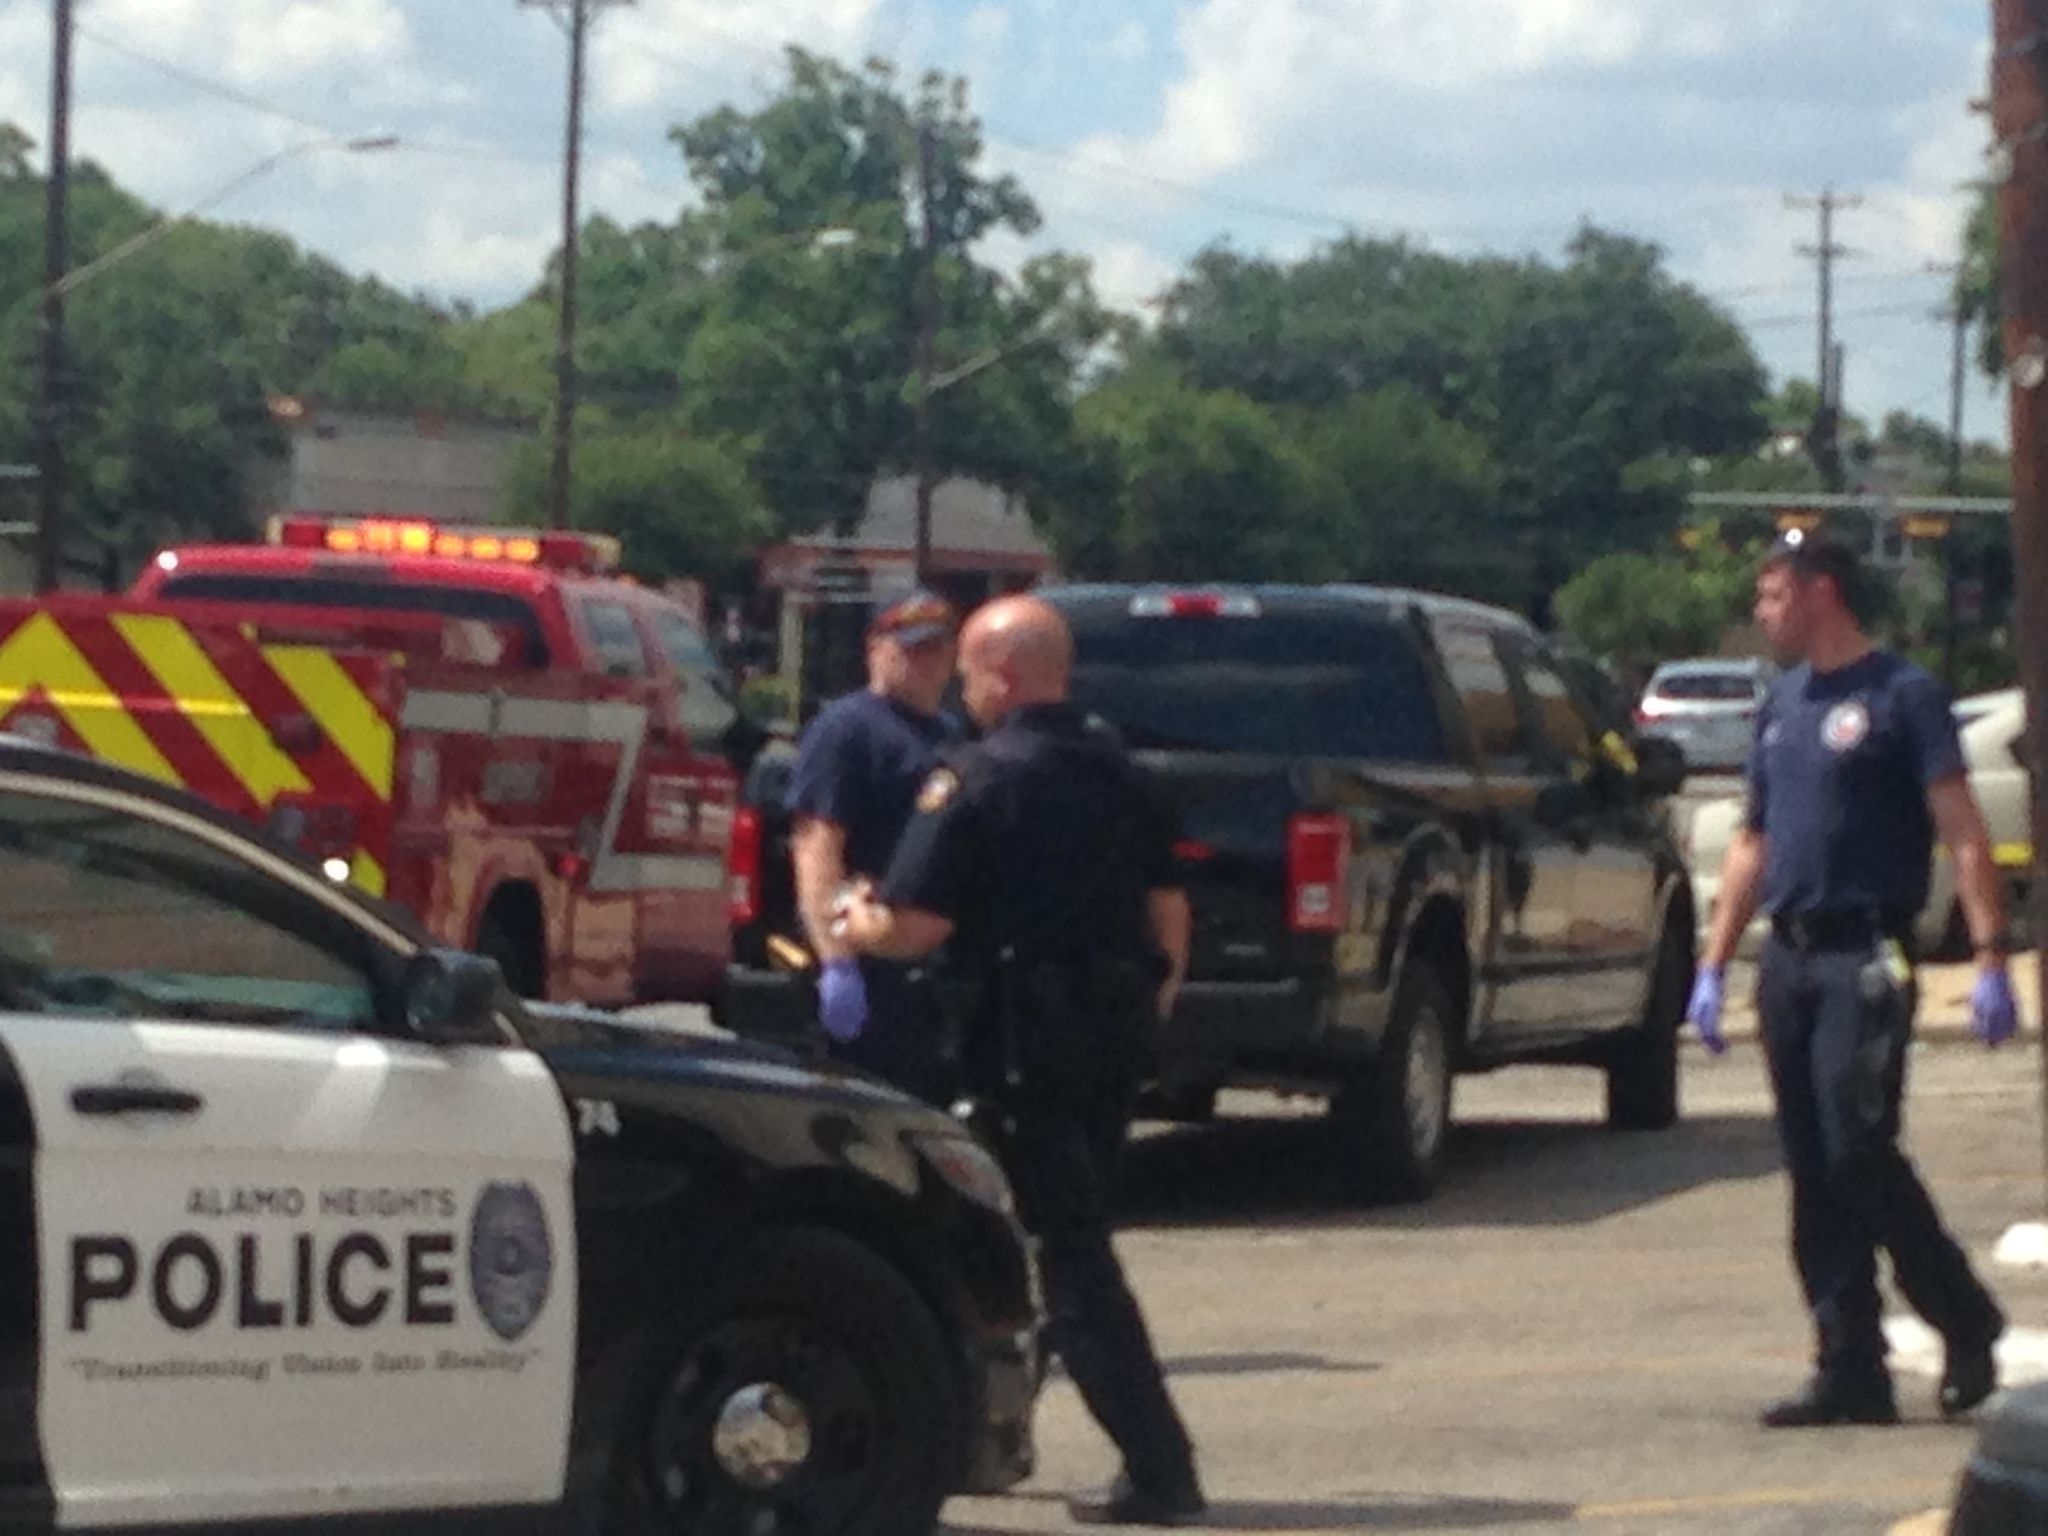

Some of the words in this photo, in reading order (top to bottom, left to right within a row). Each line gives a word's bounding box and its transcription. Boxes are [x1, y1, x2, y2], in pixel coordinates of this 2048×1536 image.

[186, 1186, 305, 1218] ALAMO
[318, 1186, 457, 1217] HEIGHTS
[68, 1230, 456, 1332] POLICE
